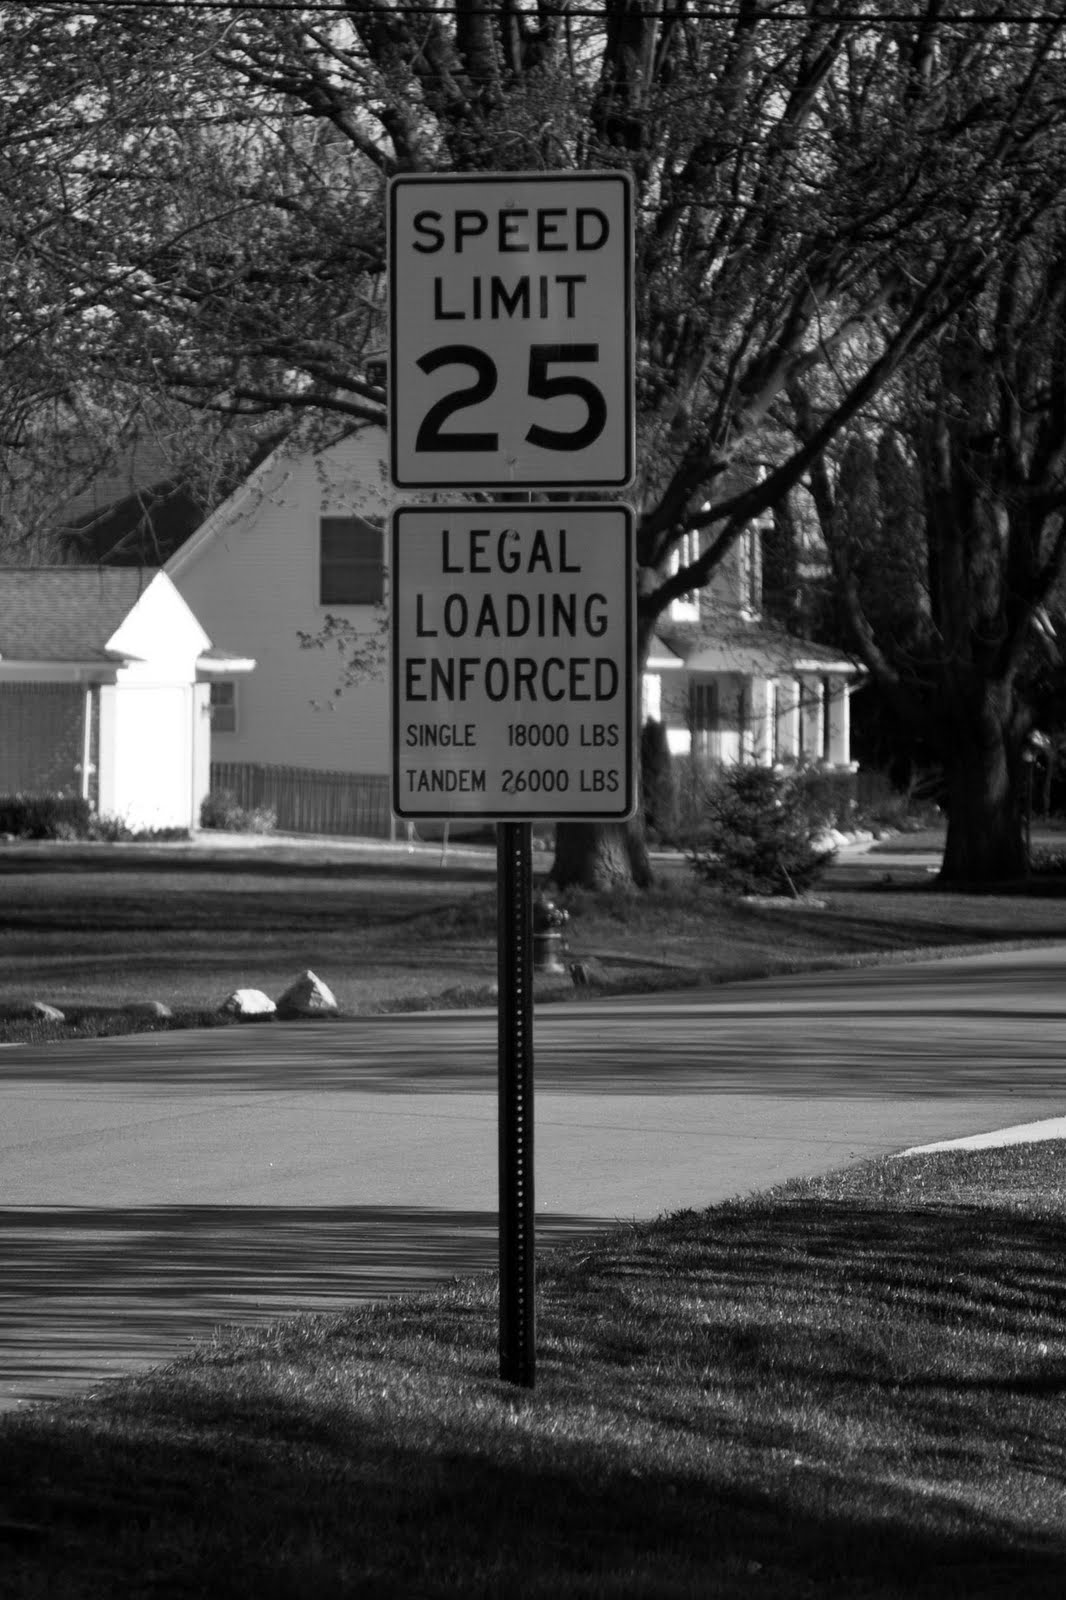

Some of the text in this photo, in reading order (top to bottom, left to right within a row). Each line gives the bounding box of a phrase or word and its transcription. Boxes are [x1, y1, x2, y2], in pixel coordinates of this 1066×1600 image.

[412, 207, 610, 254] SPEED
[434, 274, 587, 320] LIMIT
[415, 343, 608, 452] 25
[442, 529, 581, 573] LEGAL
[416, 593, 608, 638] LOADING
[405, 657, 619, 702] ENFORCED
[406, 724, 619, 747] SINGLE 18000 LBS
[406, 769, 619, 793] TANDEM 26000 LBS
